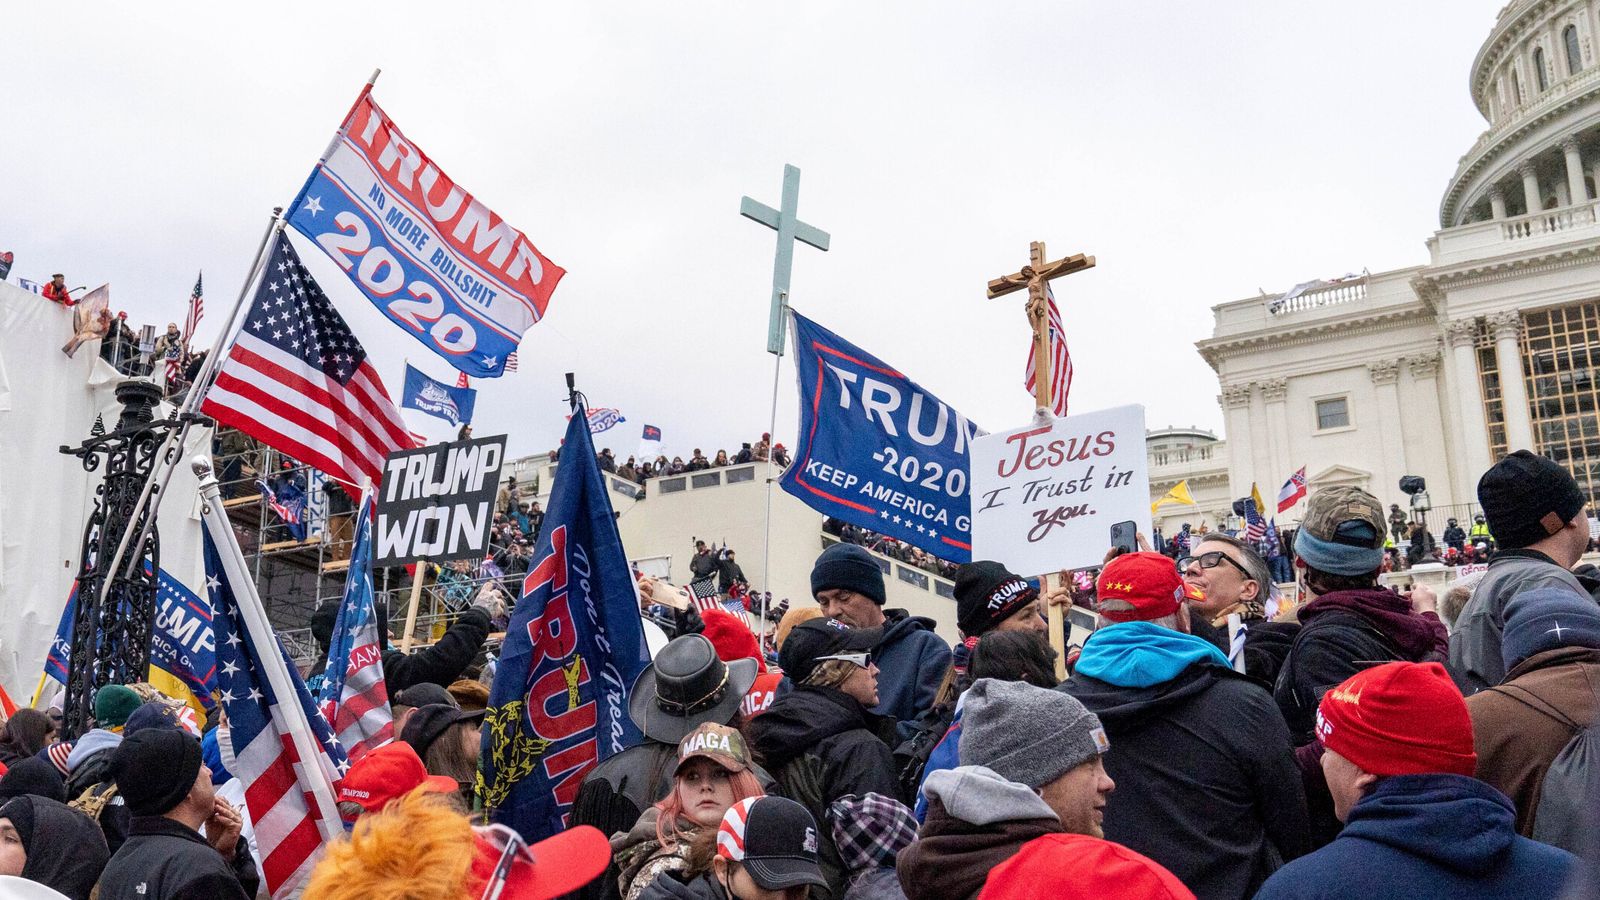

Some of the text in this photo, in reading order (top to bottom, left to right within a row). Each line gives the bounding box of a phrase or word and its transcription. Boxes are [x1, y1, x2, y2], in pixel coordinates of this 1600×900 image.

[360, 109, 544, 285] TRUMP
[368, 182, 497, 309] NO MORE BULLSHIT
[315, 211, 478, 355] 2020
[824, 360, 974, 455] TRU
[386, 443, 502, 502] TRUMP
[998, 425, 1116, 479] Jesus
[805, 458, 858, 489] KEEP
[859, 481, 948, 526] AMERICA
[978, 465, 1135, 514] I Trust in
[377, 502, 489, 559] WON
[987, 580, 1028, 609] TRUMP
[523, 524, 599, 830] TRUM
[683, 732, 731, 758] MAGA
